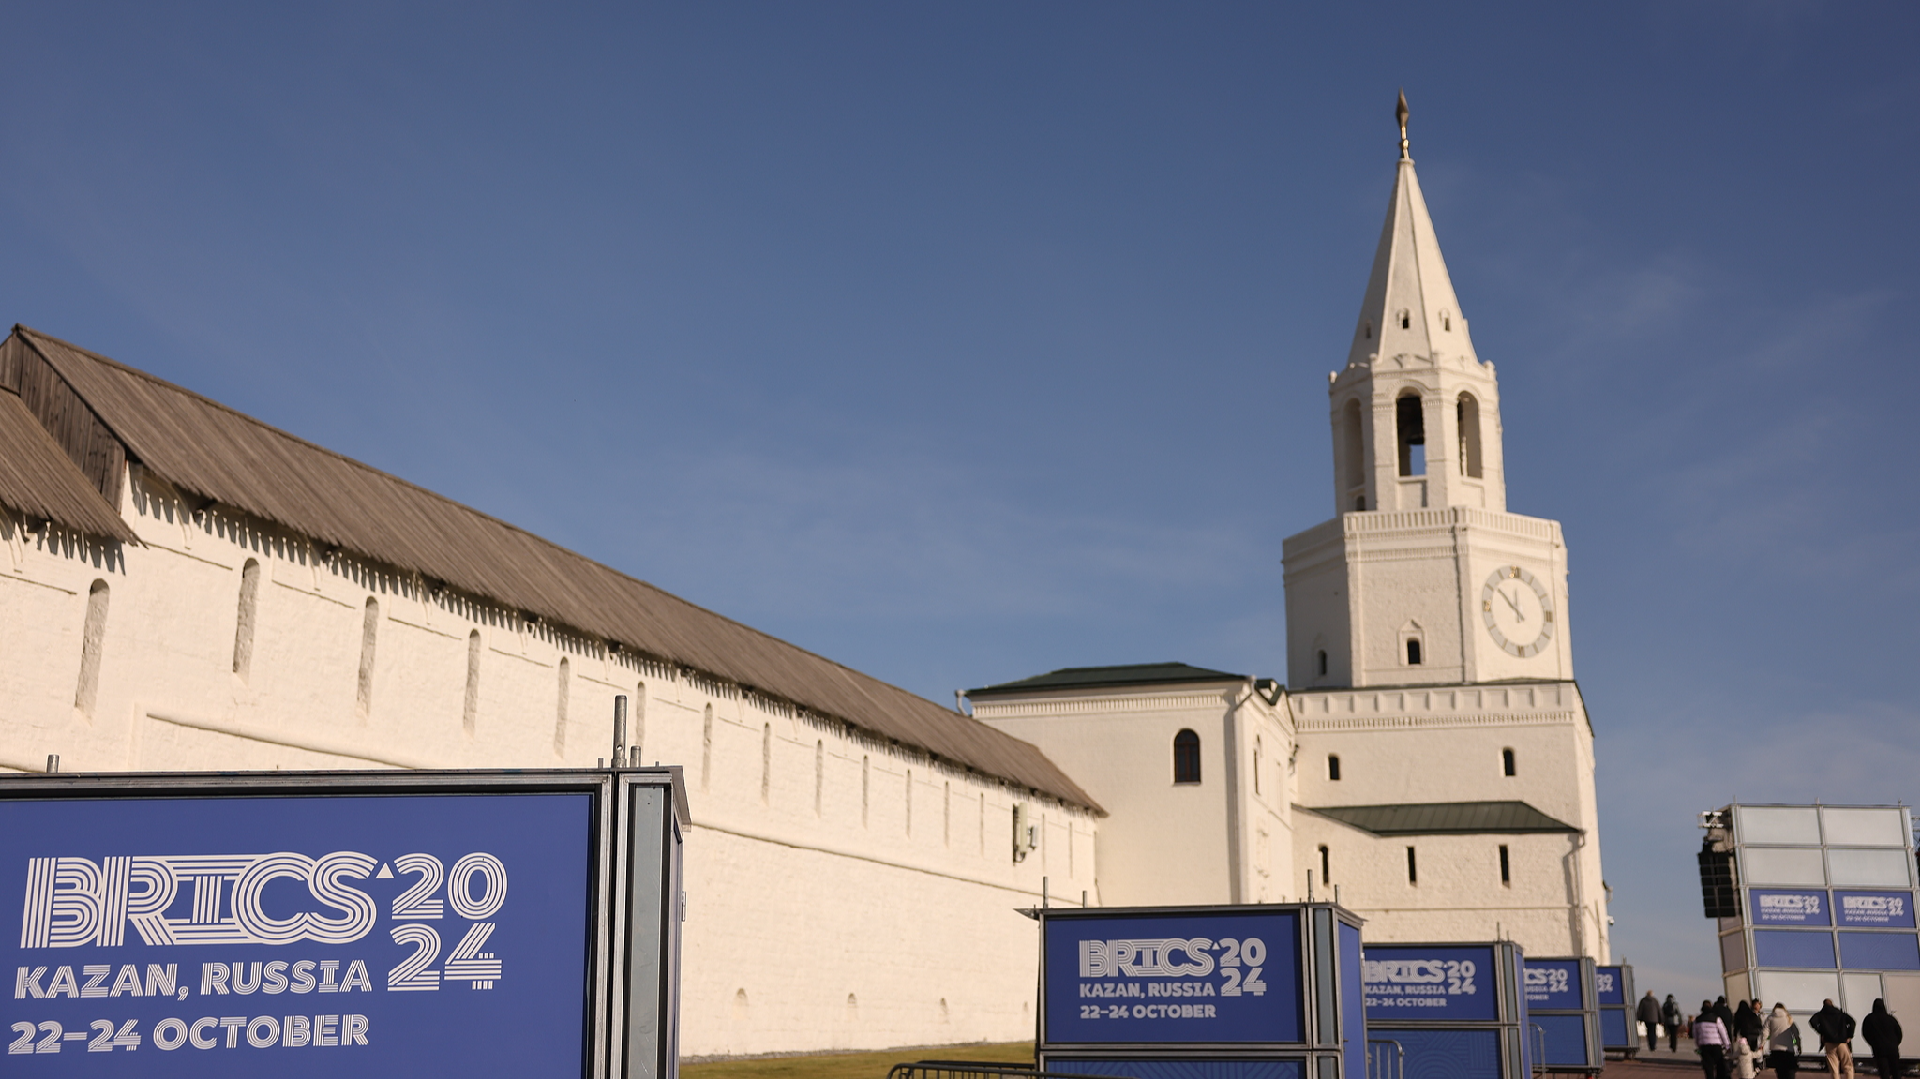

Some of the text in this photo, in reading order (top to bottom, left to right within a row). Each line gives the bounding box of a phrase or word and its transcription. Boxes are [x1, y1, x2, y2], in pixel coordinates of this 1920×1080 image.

[20, 851, 508, 949] BRICS 20
[387, 922, 503, 992] 24
[1078, 937, 1267, 978] BRICS 20
[1365, 959, 1446, 984] BRICS
[14, 959, 373, 1001] KAZAN, RUSSIA
[1079, 982, 1216, 999] KAZAN, RUSSIA
[1220, 967, 1268, 997] 24
[1404, 984, 1447, 995] RUSSIA
[1132, 1004, 1217, 1018] OCTOBER
[1396, 997, 1448, 1007] OCTOBER
[153, 1014, 370, 1050] OCTOBER
